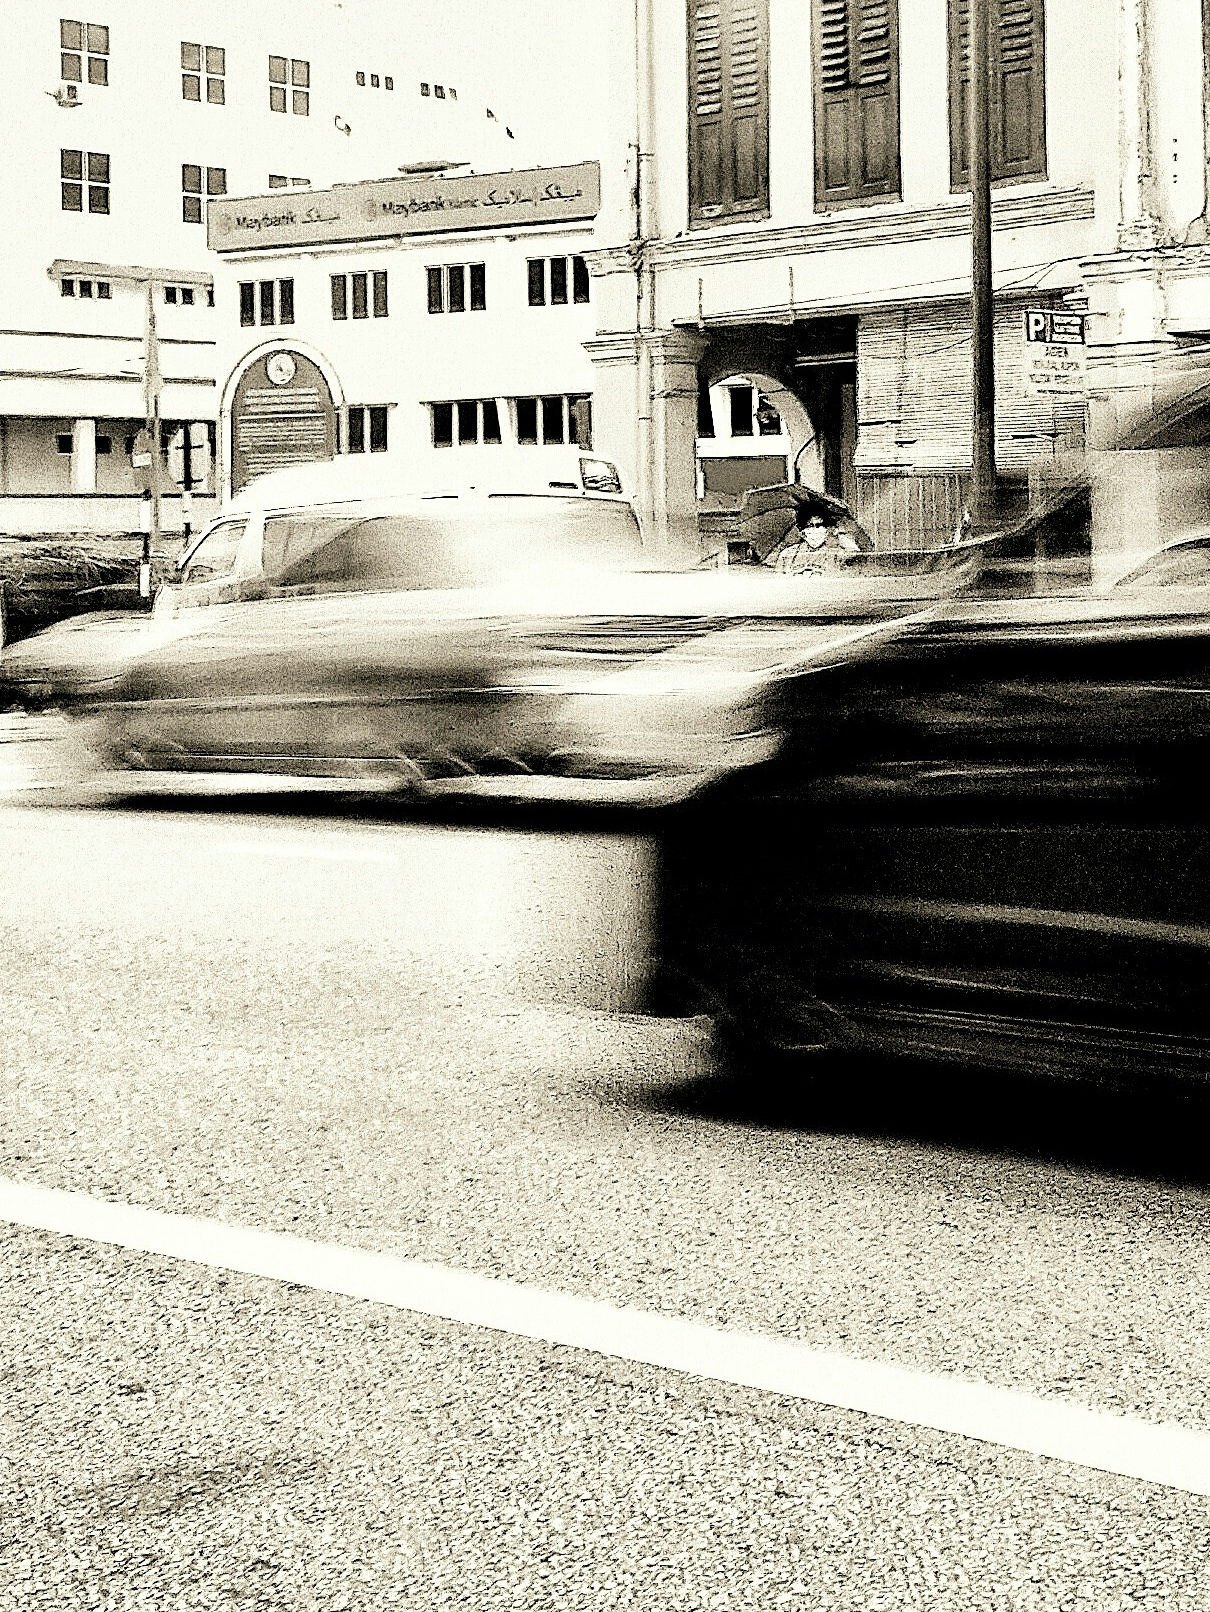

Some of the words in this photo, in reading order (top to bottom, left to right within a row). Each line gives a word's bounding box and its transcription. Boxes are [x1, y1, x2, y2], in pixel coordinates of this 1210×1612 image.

[382, 196, 445, 218] Maybank
[235, 211, 296, 233] Maybank
[1028, 313, 1046, 341] P
